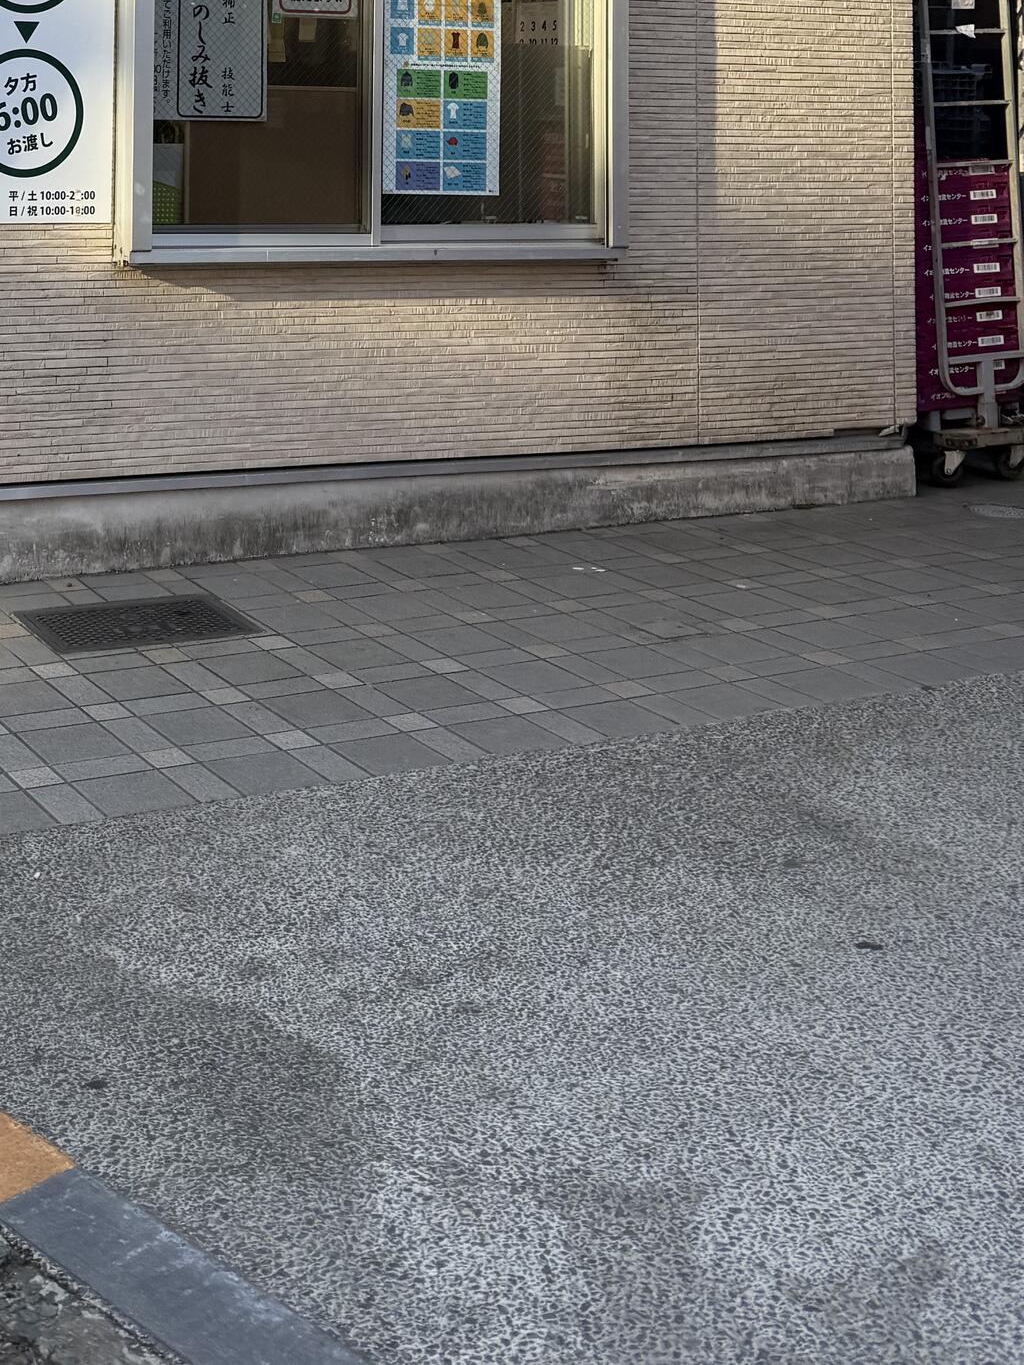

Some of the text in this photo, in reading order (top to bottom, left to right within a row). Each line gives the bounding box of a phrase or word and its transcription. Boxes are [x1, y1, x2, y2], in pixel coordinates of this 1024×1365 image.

[520, 21, 525, 32] 2
[531, 21, 536, 32] 3
[542, 20, 547, 31] 4
[3, 72, 38, 97] 夕方
[221, 66, 235, 113] 技能士
[6, 133, 54, 156] お渡し
[39, 190, 96, 201] 10:00-2:00
